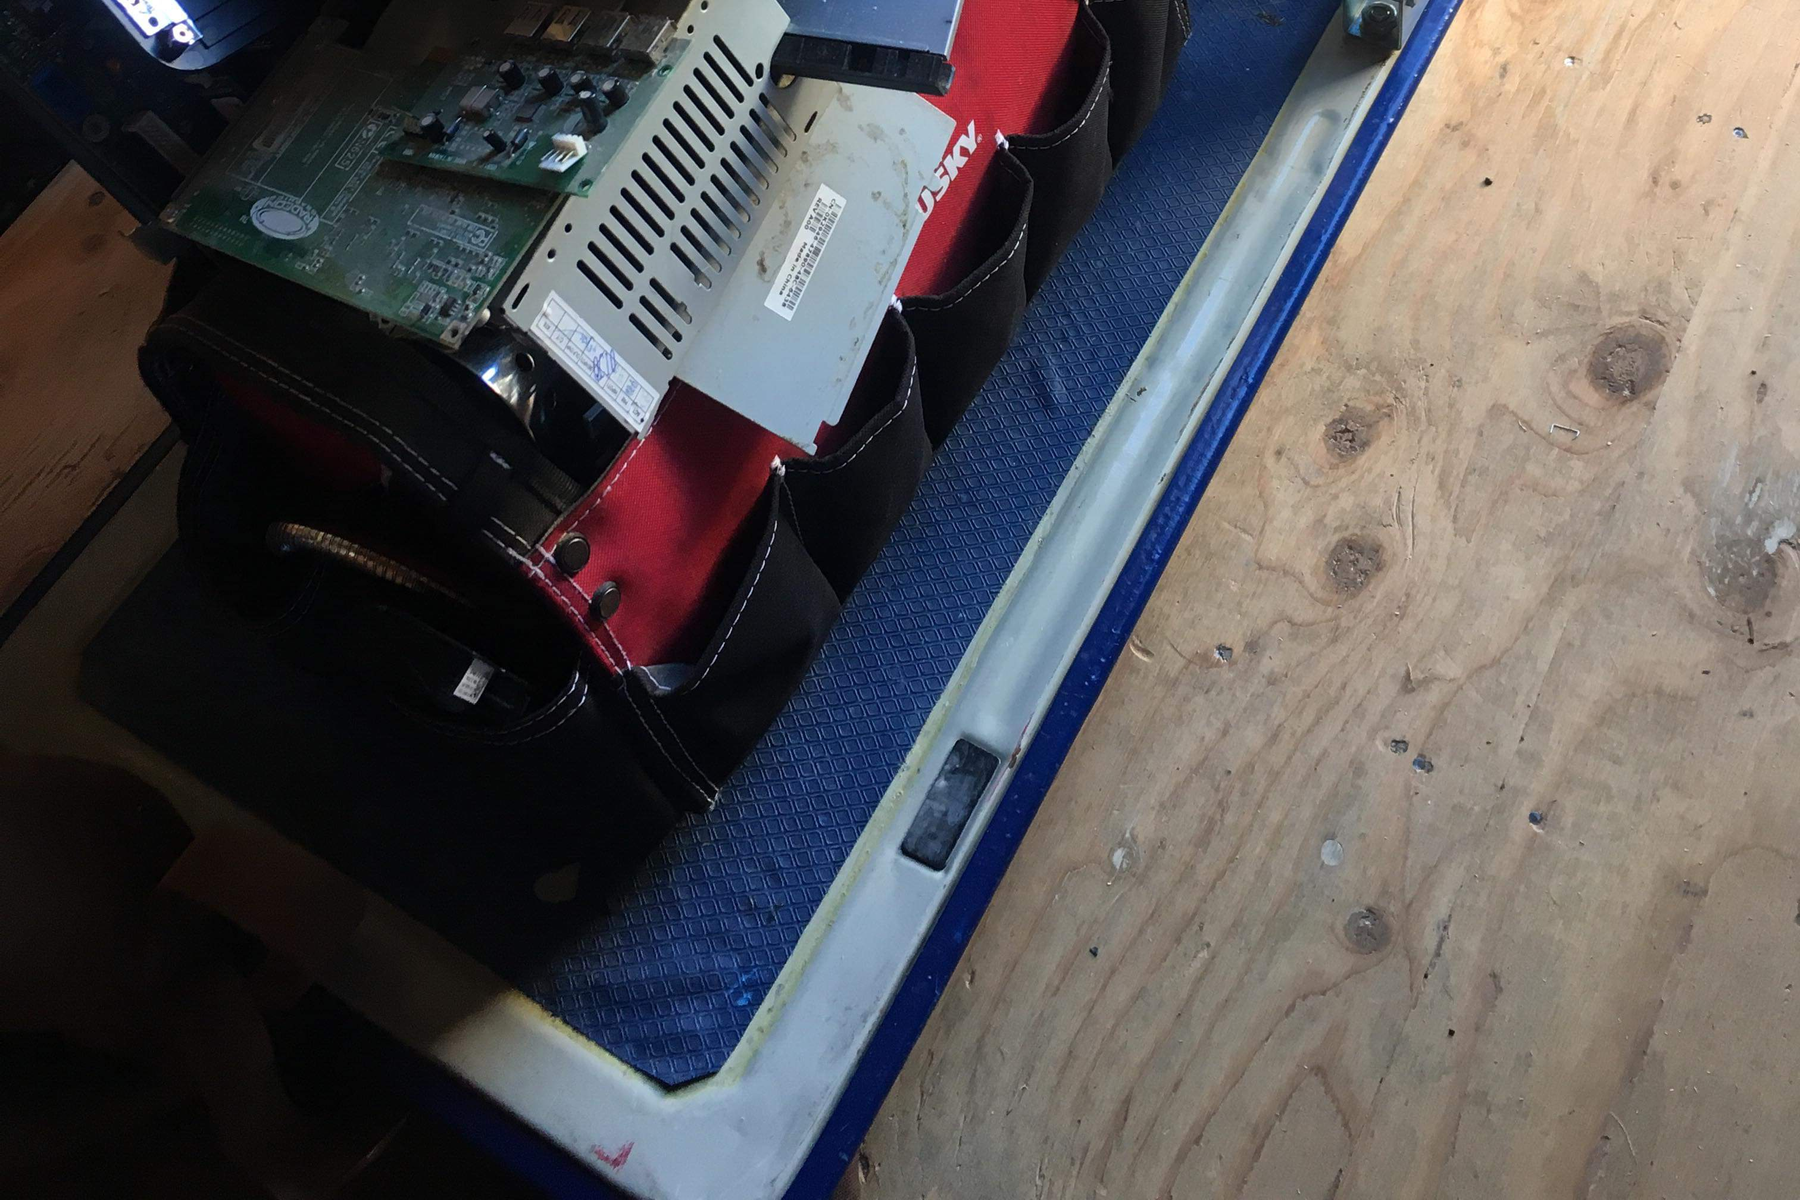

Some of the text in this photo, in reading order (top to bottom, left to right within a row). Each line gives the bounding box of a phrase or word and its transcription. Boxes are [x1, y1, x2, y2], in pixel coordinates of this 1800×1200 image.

[914, 119, 977, 215] USKY
[263, 199, 315, 225] RADEON
[803, 196, 822, 230] REV A00
[778, 241, 807, 296] Made in China
